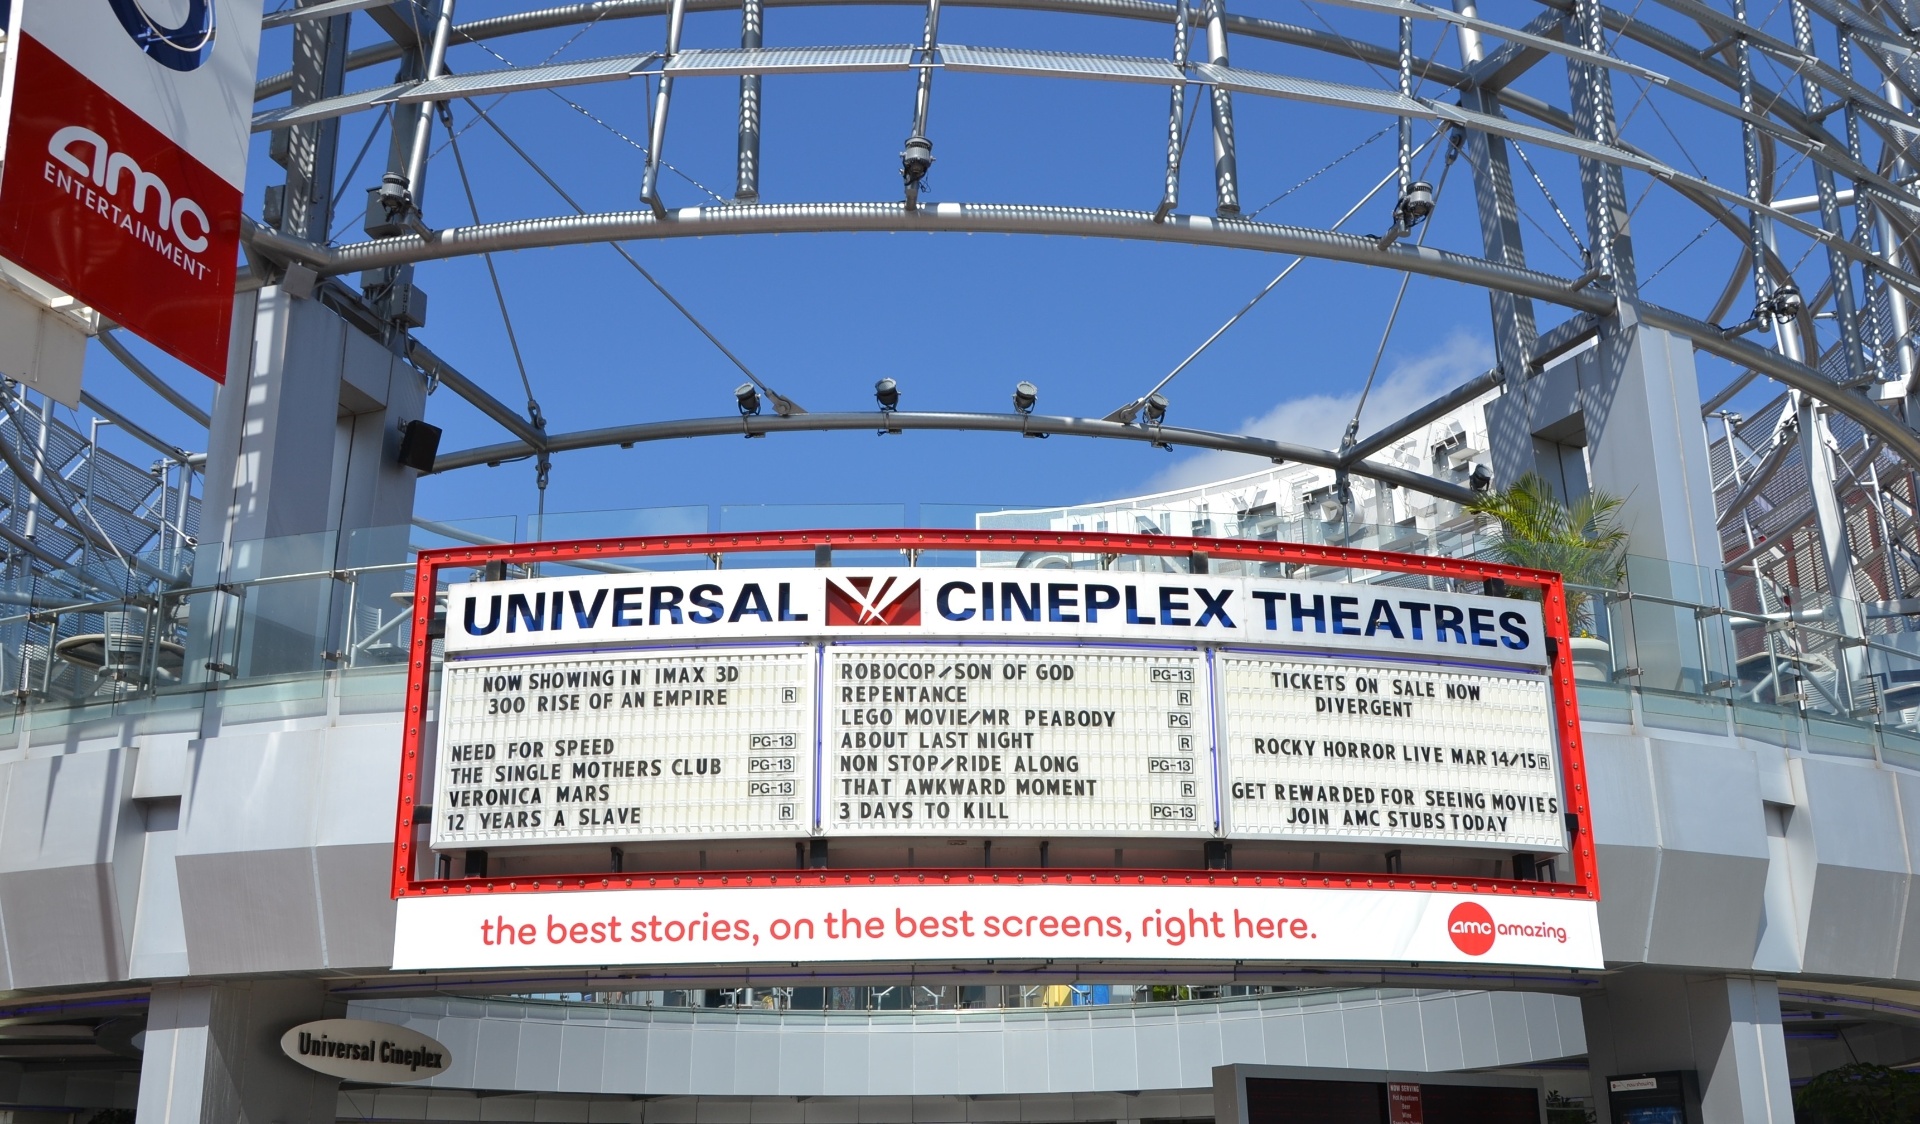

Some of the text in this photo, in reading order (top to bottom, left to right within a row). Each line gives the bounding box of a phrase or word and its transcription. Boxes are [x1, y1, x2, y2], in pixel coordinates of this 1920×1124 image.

[44, 160, 204, 280] ENTERTAINMENT
[463, 581, 1530, 651] UNIVERSAL CINEPLEX THEATRES
[483, 665, 739, 693] NOW SHOWING IN IMAX 3D
[841, 662, 1192, 681] ROBOCOP/SON OF GOD PG-13
[842, 685, 1189, 703] REPENTANCE R
[1271, 671, 1480, 701] TICKETS ON SALE NOW
[488, 688, 794, 715] 300 RISE OF AN EMPIRE R
[1315, 696, 1413, 718] DIVERGENT
[842, 708, 1189, 728] LEGO MOVIE/MR PEABODY PG
[451, 735, 793, 762] NEED FOR SPEED PG-13
[841, 731, 1190, 749] ABOUT LAST NIGHT R
[1254, 737, 1548, 769] ROCKY HORROR LIVE MAR 14/15 R
[450, 758, 792, 785] THE SINGLE MOTHERS CLUB PG-13
[840, 754, 1191, 773] NON STOP/RIDE ALONG PG-13
[449, 782, 792, 808] VERONICA MARS PG-13
[841, 778, 1193, 796] THAT AWKWARD MOMENT R
[1231, 781, 1558, 814] GET REWARDED FOR SEEING MOVIES
[447, 806, 791, 831] 12 YEARS A SLAVE R
[839, 801, 1194, 820] 3 DAYS TO KILL PG-13
[1286, 807, 1508, 832] JOIN AMC STUBS TODAY
[480, 907, 1317, 947] the best stories, on the best screens, right here.
[1497, 922, 1567, 943] amazing
[298, 1032, 442, 1072] Universal Cineplex
